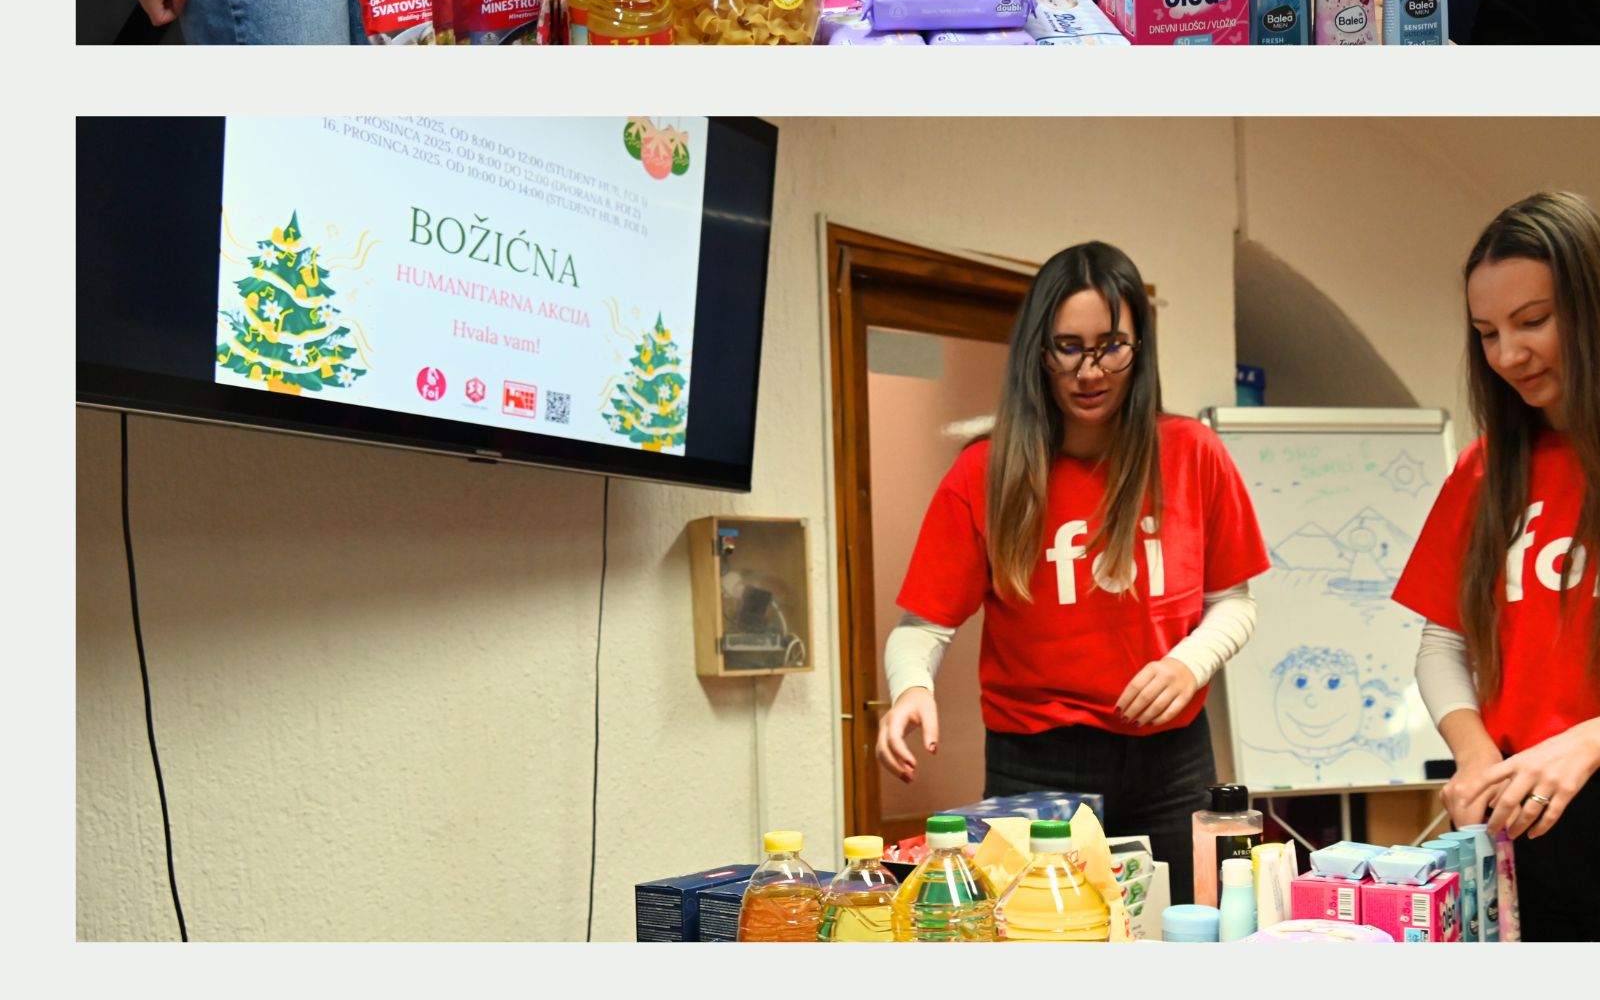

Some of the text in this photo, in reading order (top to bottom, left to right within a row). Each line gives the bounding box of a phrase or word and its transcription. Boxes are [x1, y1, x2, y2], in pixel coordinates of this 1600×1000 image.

[1408, 0, 1434, 10] Balea
[1267, 14, 1293, 24] Balea
[1338, 16, 1364, 26] Balea
[1403, 21, 1438, 31] SENSITIVE
[1149, 23, 1178, 35] DNEVNI
[1179, 21, 1206, 32] ULOŠCI
[1261, 37, 1284, 45] FRESH
[450, 126, 469, 142] OD
[471, 134, 496, 152] 8:00
[498, 143, 516, 159] DO
[518, 151, 544, 170] 12:00
[322, 116, 340, 133] 16.
[343, 123, 410, 157] PROSINCA
[445, 158, 465, 175] OD
[468, 165, 497, 185] 10:00
[498, 176, 516, 192] DO
[518, 183, 545, 202] 14:00
[456, 145, 476, 161] OD
[478, 152, 501, 170] 8:00
[504, 161, 522, 177] DO
[524, 169, 550, 188] 12:00
[409, 206, 581, 289] BOŽIĆNA
[396, 263, 591, 329] HUMANITARNA AKCIJA
[452, 319, 541, 355] Hvala vam!
[421, 384, 440, 399] foi
